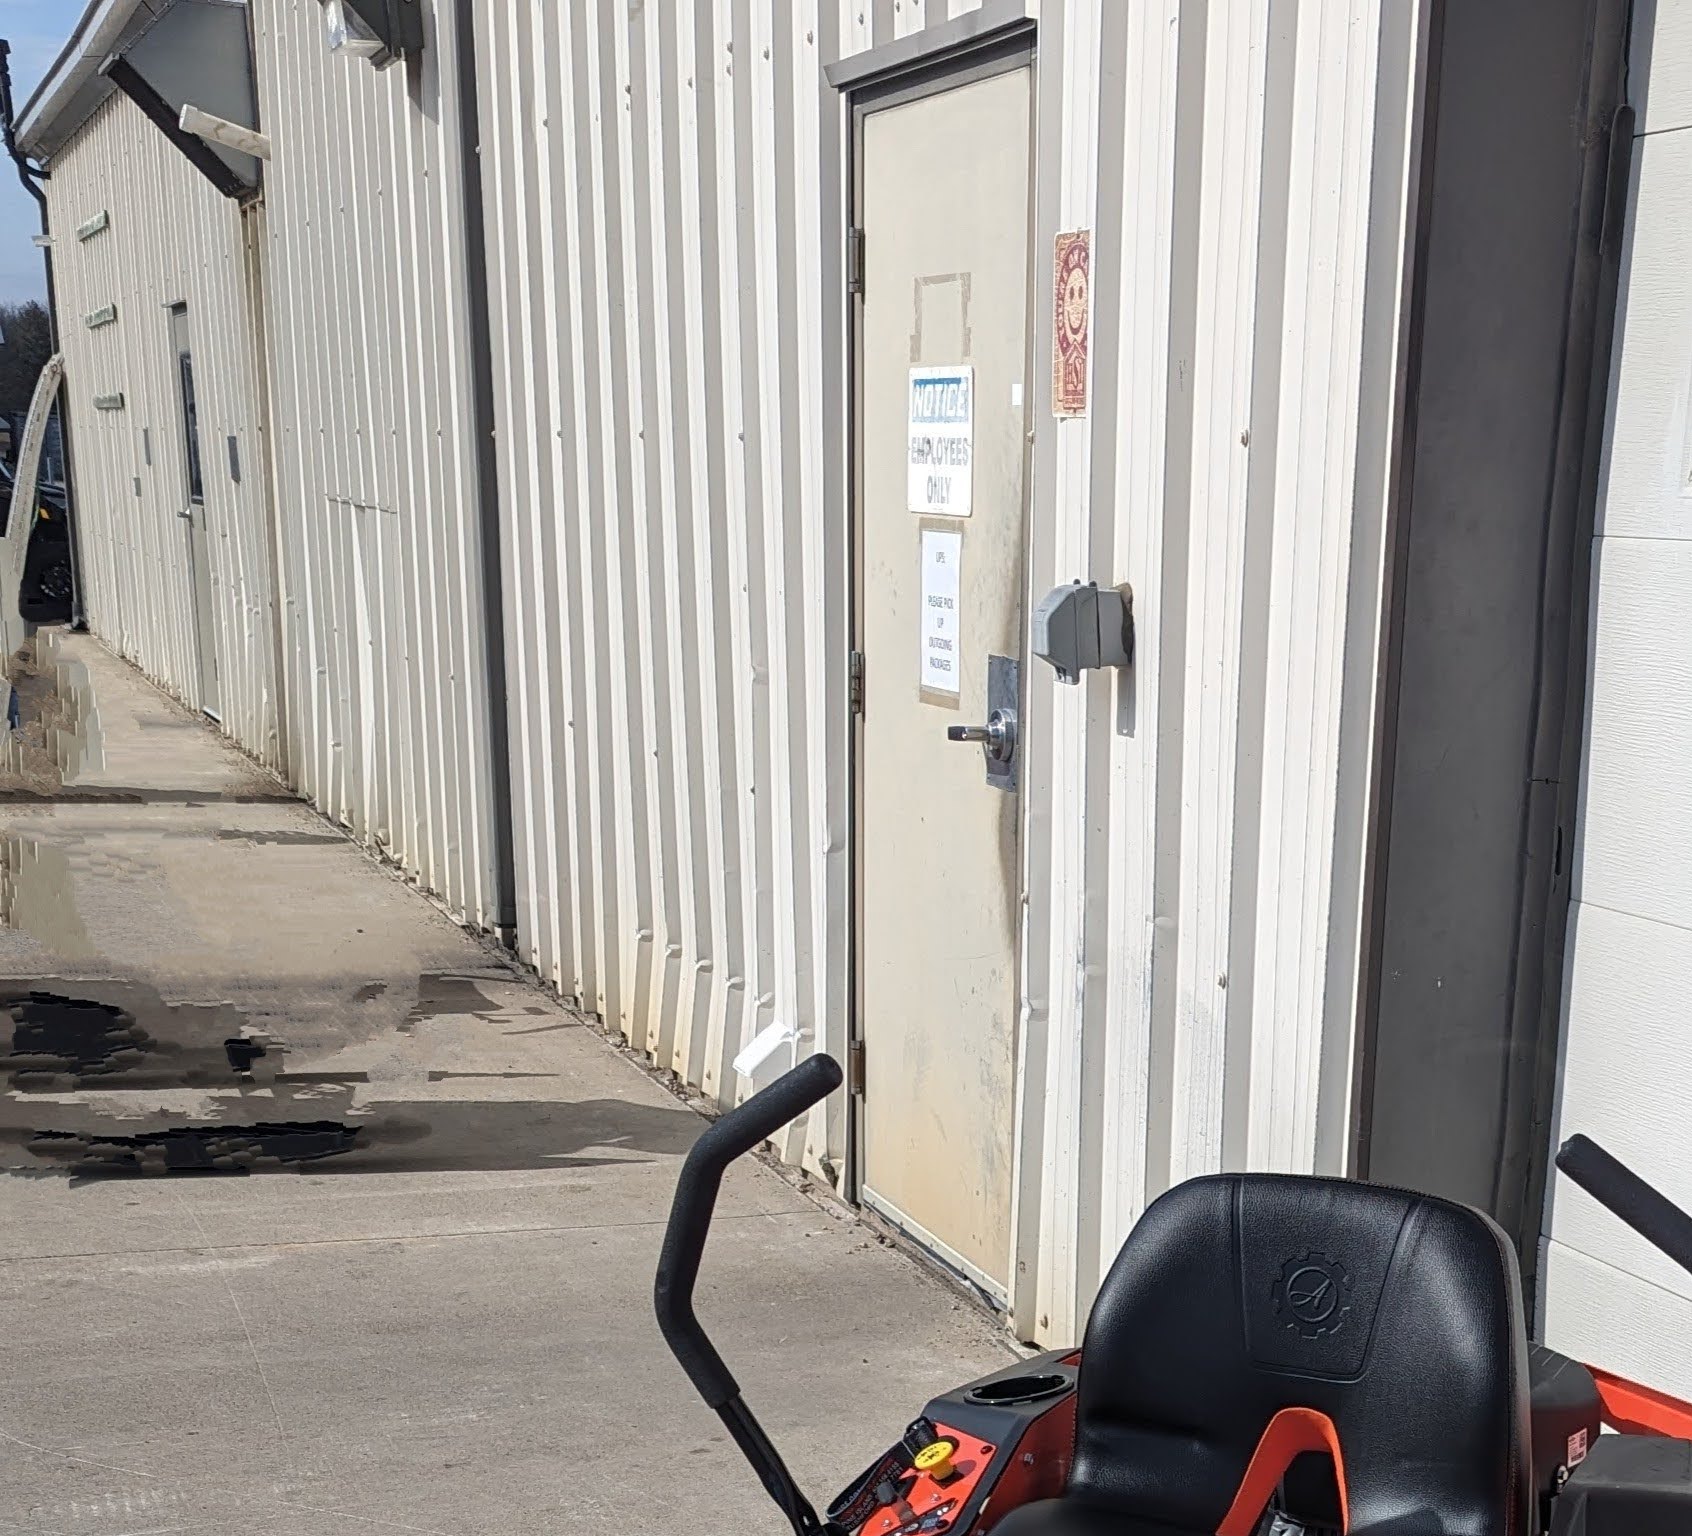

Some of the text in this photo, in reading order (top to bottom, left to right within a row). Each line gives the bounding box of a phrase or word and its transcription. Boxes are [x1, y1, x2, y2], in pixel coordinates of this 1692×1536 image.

[913, 381, 968, 418] NOTICE
[911, 436, 969, 466] EMPLOYEES
[926, 475, 952, 504] ONLY
